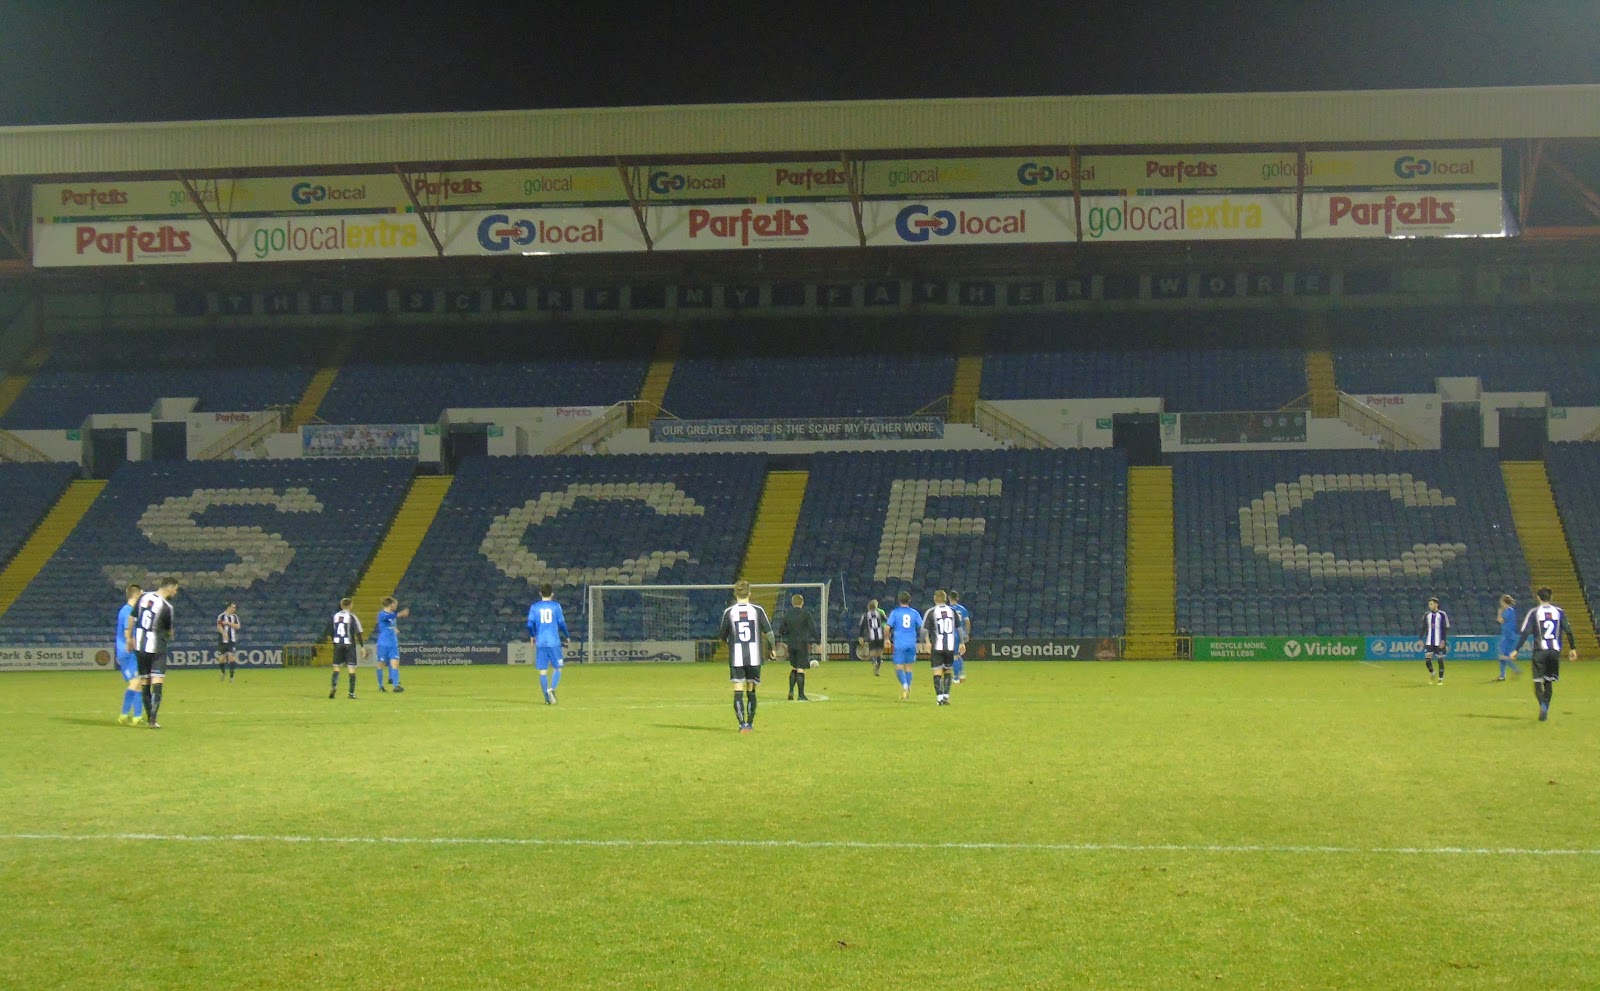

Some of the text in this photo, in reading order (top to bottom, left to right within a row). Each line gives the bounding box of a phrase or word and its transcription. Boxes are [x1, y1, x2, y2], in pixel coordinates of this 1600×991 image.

[1055, 166, 1095, 182] loal
[1146, 160, 1218, 183] Parfetts
[1433, 159, 1474, 175] local
[687, 174, 726, 190] local
[776, 168, 847, 190] Parfetts
[61, 188, 128, 210] Parfetts
[328, 184, 366, 200] local
[960, 209, 1026, 235] local
[1329, 195, 1456, 234] Parfetts
[539, 218, 604, 244] local
[688, 208, 809, 246] Parfetts
[76, 225, 192, 262] Parfetts
[662, 422, 935, 436] OUR GREATEST PRIDE IS THE SCARF MY FATHER WORE
[141, 609, 152, 630] 6
[539, 608, 553, 624] 10
[902, 614, 911, 629] 8
[336, 622, 346, 637] 4
[738, 621, 751, 642] 5
[937, 617, 953, 634] 10
[1544, 620, 1555, 640] 2
[24, 650, 32, 660] &
[36, 651, 63, 660] Sons
[67, 650, 84, 660] Ltd
[419, 646, 442, 654] County
[471, 645, 501, 653] Academy
[991, 642, 1080, 658] Legendary
[1304, 642, 1358, 656] Viridor
[1389, 641, 1424, 653] JAKO
[1454, 641, 1489, 653] JAKO
